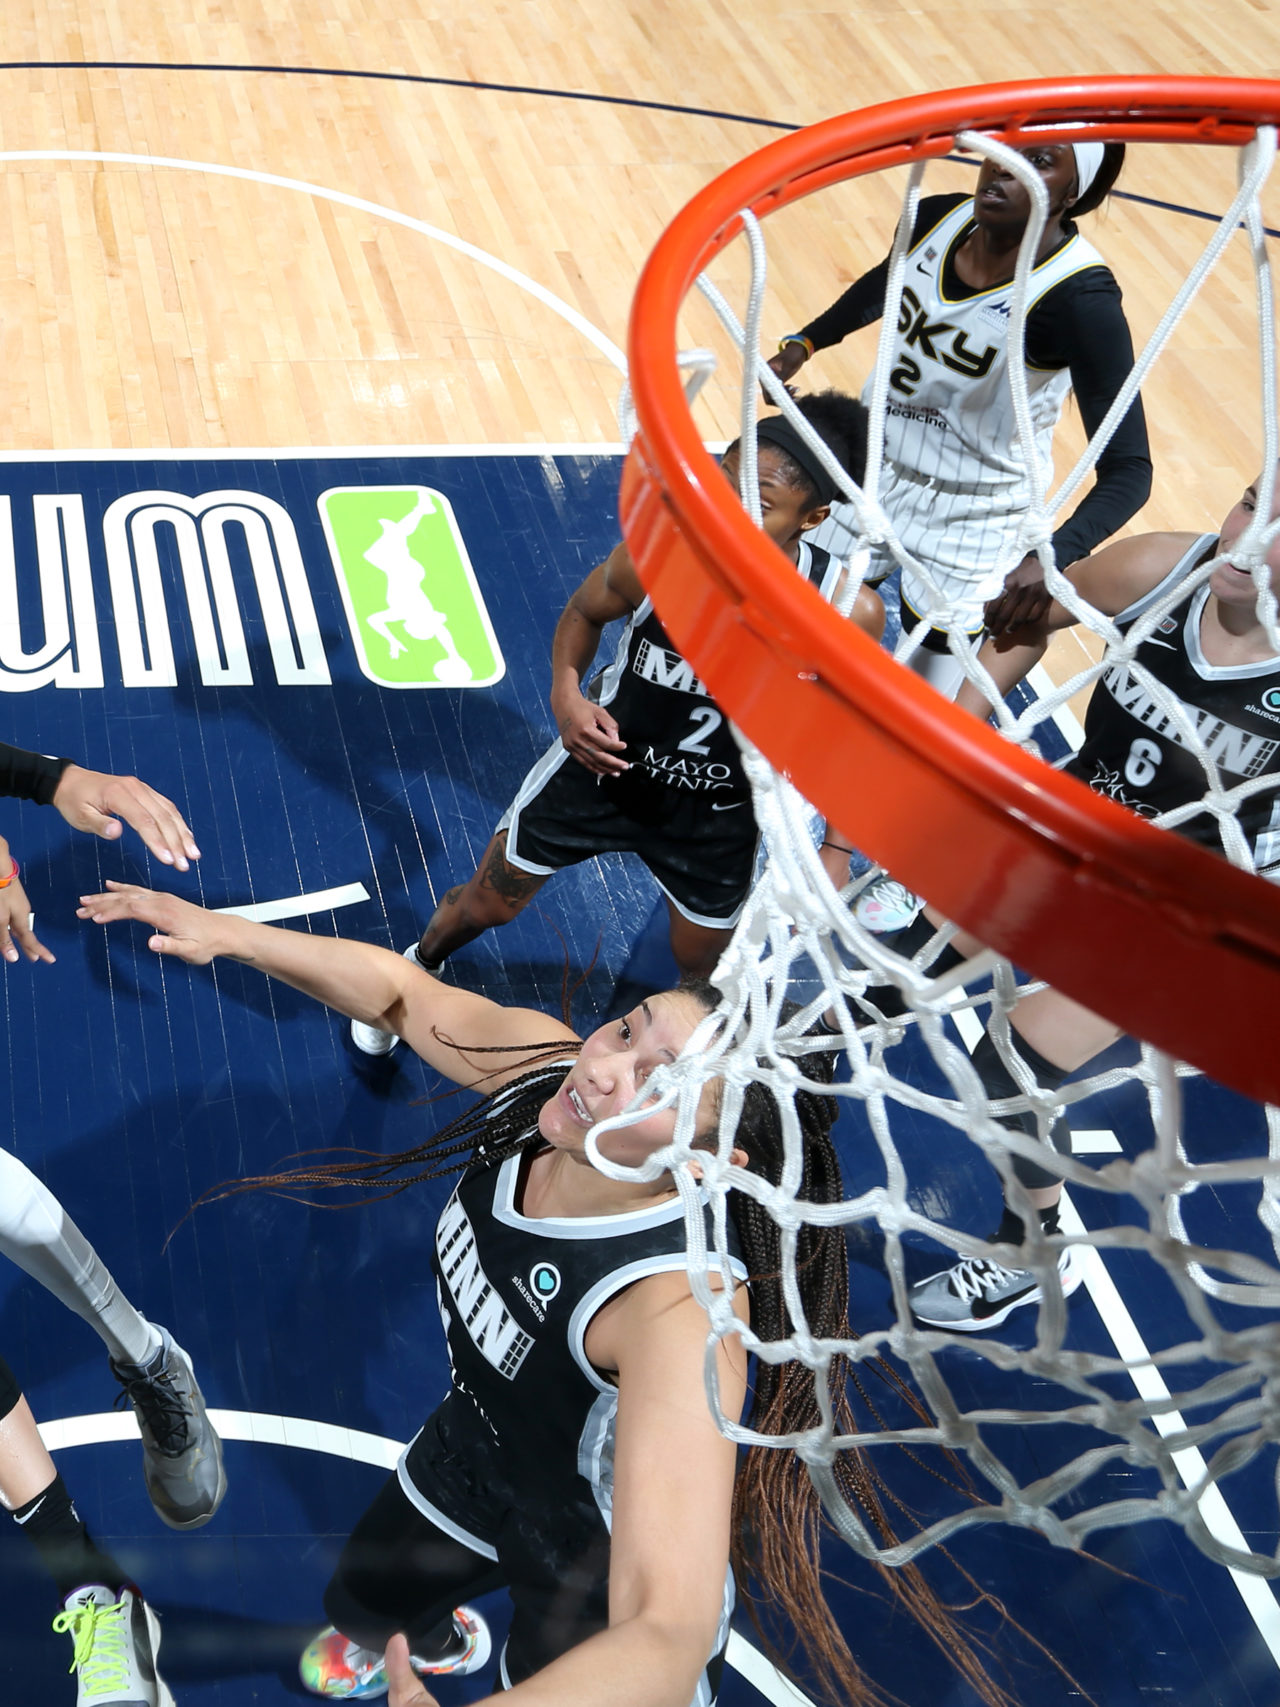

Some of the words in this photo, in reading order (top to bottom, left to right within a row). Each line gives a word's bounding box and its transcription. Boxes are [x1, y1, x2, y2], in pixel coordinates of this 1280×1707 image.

[897, 285, 999, 379] SKY
[889, 354, 922, 397] 2
[677, 705, 723, 757] 2
[1244, 703, 1280, 725] shareca
[644, 745, 732, 780] MAYO
[1124, 737, 1163, 788] 6
[511, 1275, 546, 1324] sharecare
